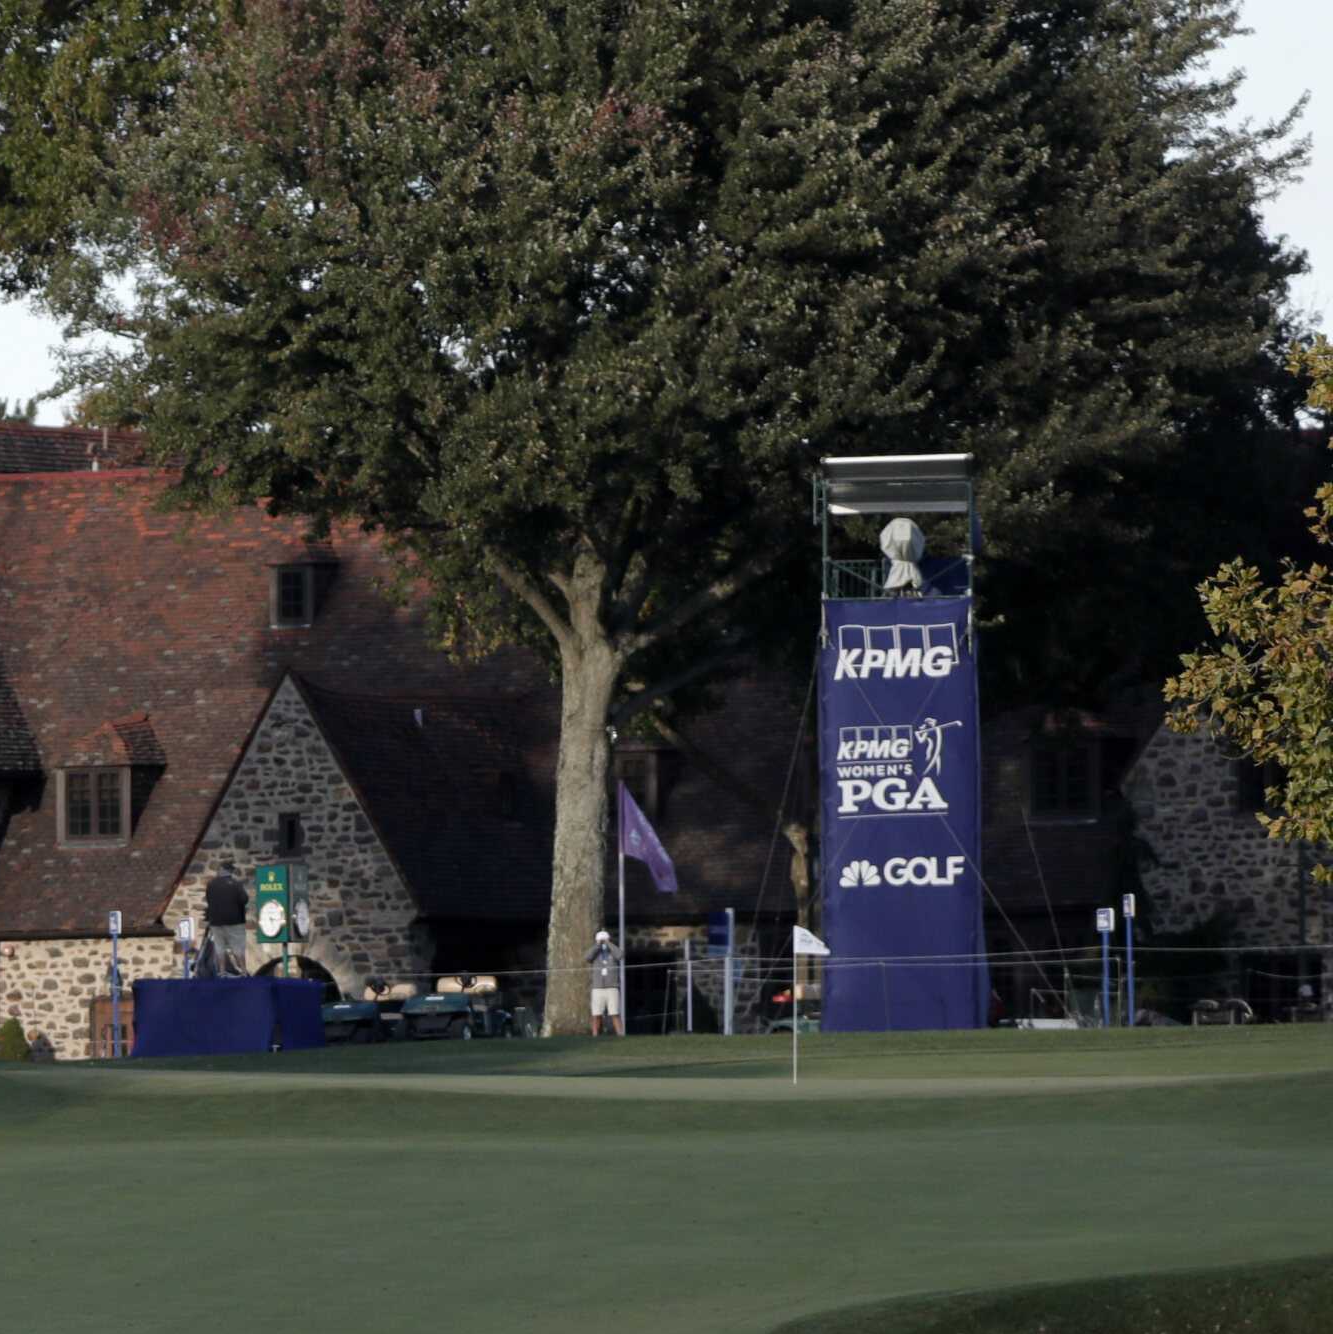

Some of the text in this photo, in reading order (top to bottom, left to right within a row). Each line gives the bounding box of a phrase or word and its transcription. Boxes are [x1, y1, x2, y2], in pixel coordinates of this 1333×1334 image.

[834, 645, 954, 681] KPMG
[837, 738, 910, 760] KPMG
[837, 763, 914, 778] WOMEN'S
[837, 777, 950, 813] PGA
[883, 856, 966, 887] GOLF
